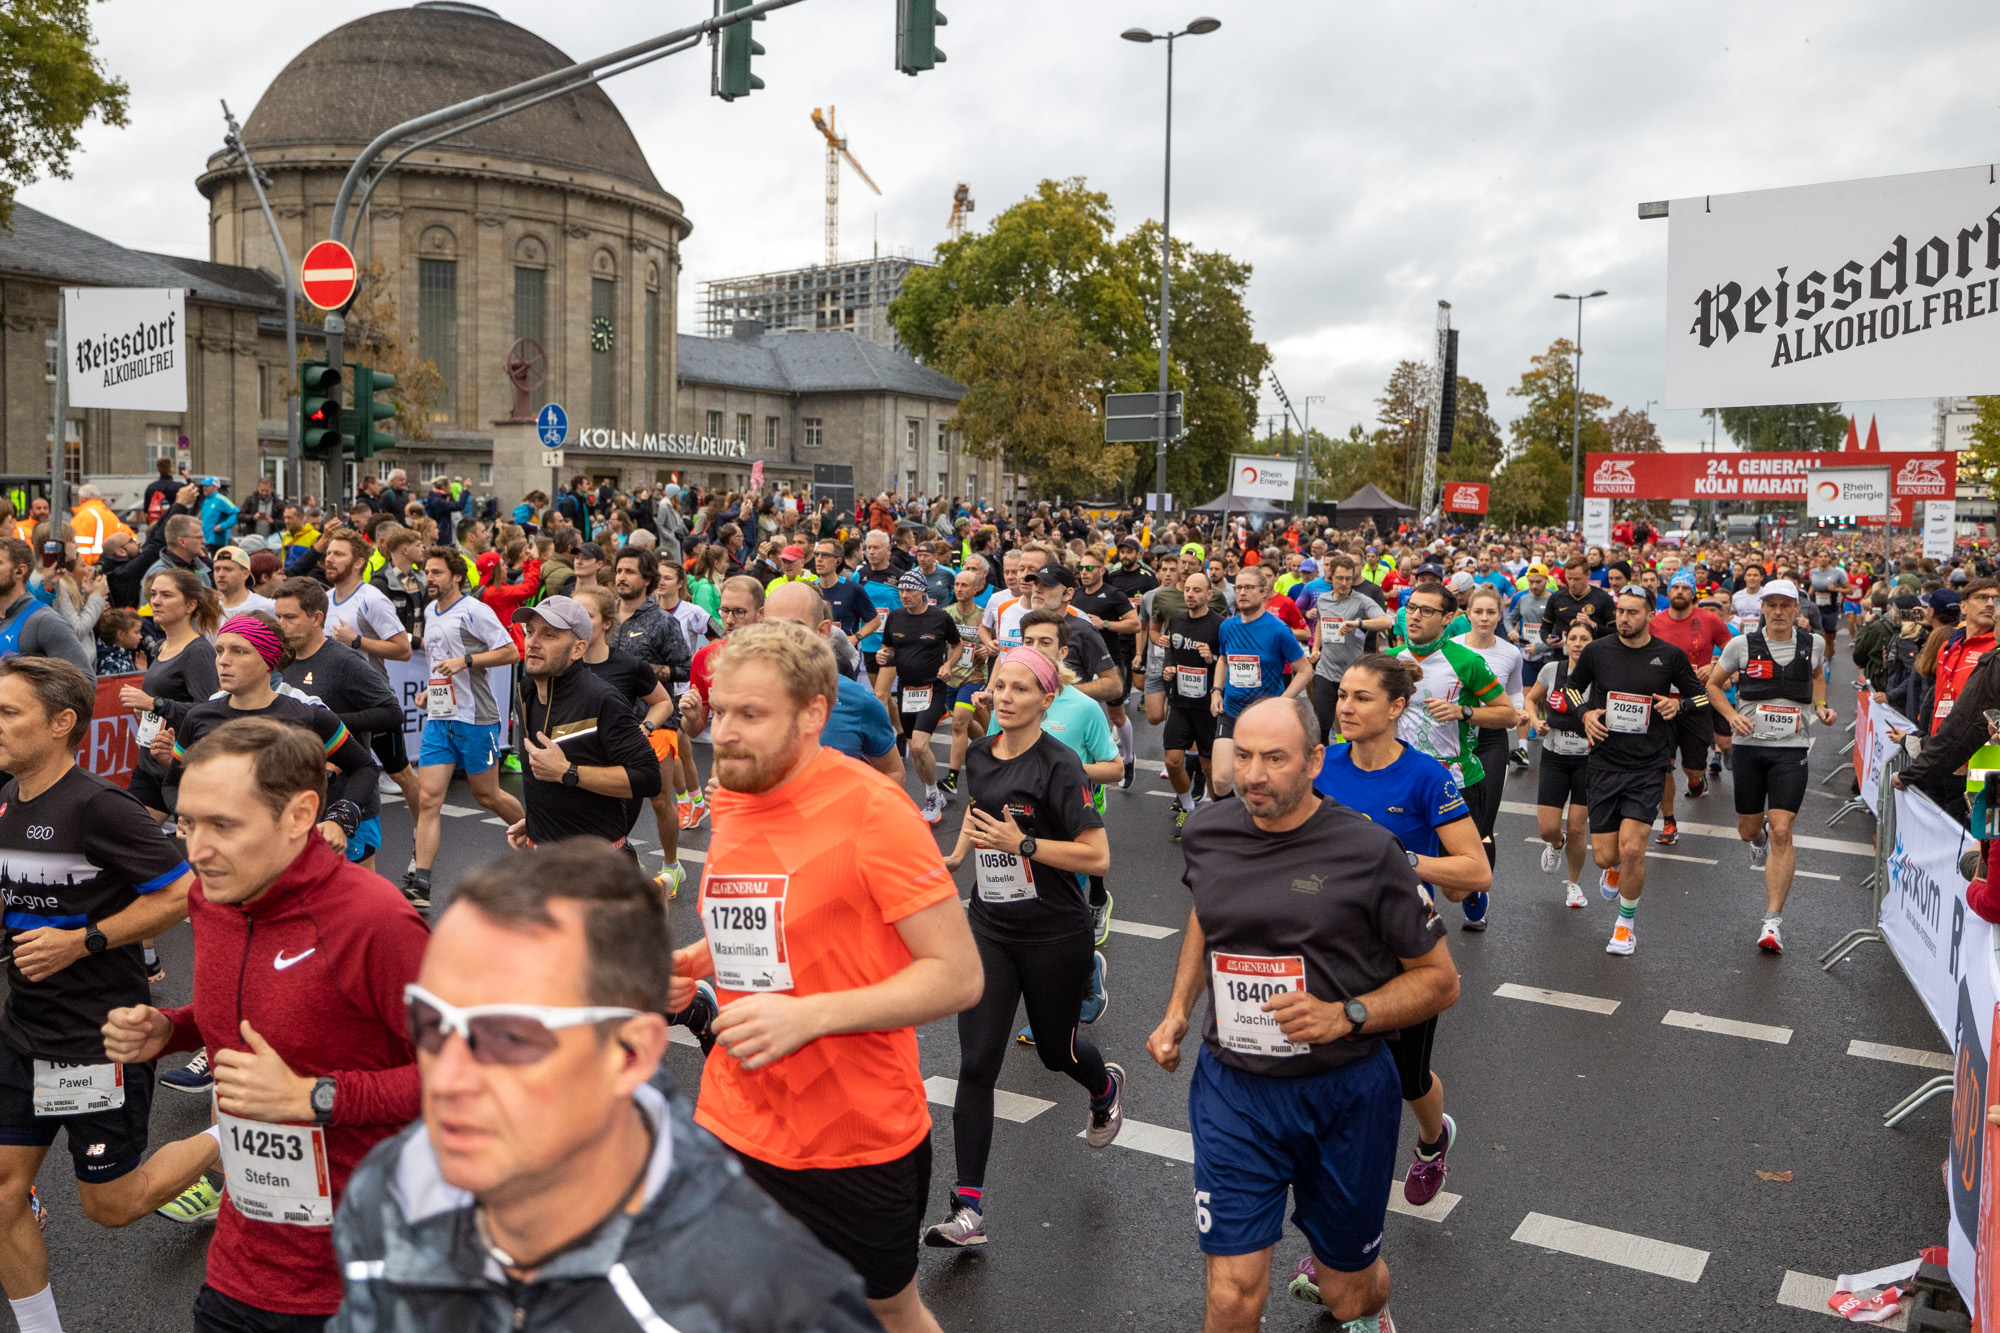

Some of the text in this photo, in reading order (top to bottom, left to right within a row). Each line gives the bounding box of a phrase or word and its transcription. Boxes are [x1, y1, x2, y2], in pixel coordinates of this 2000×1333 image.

[1771, 277, 2000, 368] ALKOHOLFREI
[76, 310, 176, 374] Reissdorf
[103, 349, 174, 388] ALKOHOLFREI
[579, 427, 637, 450] KÖLN
[1707, 459, 1733, 475] 24.
[1260, 469, 1283, 478] Rhein
[1259, 477, 1289, 487] Energie
[1694, 476, 1732, 494] KÖLN
[1843, 482, 1873, 491] Rhein
[1593, 485, 1634, 494] GENERALI
[1896, 486, 1945, 495] GENERALI
[1843, 491, 1884, 501] Energie
[1181, 674, 1202, 683] 18536
[1613, 703, 1644, 714] 20254
[1617, 715, 1638, 723] Marcus
[1764, 714, 1794, 724] 16355
[979, 853, 1018, 868] 10586
[986, 874, 1015, 883] Isabelle
[720, 881, 768, 894] GENERALI
[1900, 853, 1941, 934] pixum
[711, 906, 767, 930] 17289
[714, 941, 769, 956] Maximilian
[1238, 960, 1286, 974] GENERALI
[1236, 1036, 1258, 1044] GENERALI
[1270, 1045, 1292, 1053] PUMA
[59, 1076, 93, 1089] Pawel
[88, 1100, 109, 1109] PUMA
[230, 1125, 304, 1162] 14253
[245, 1168, 290, 1188] Stefan
[284, 1211, 310, 1221] PUMA
